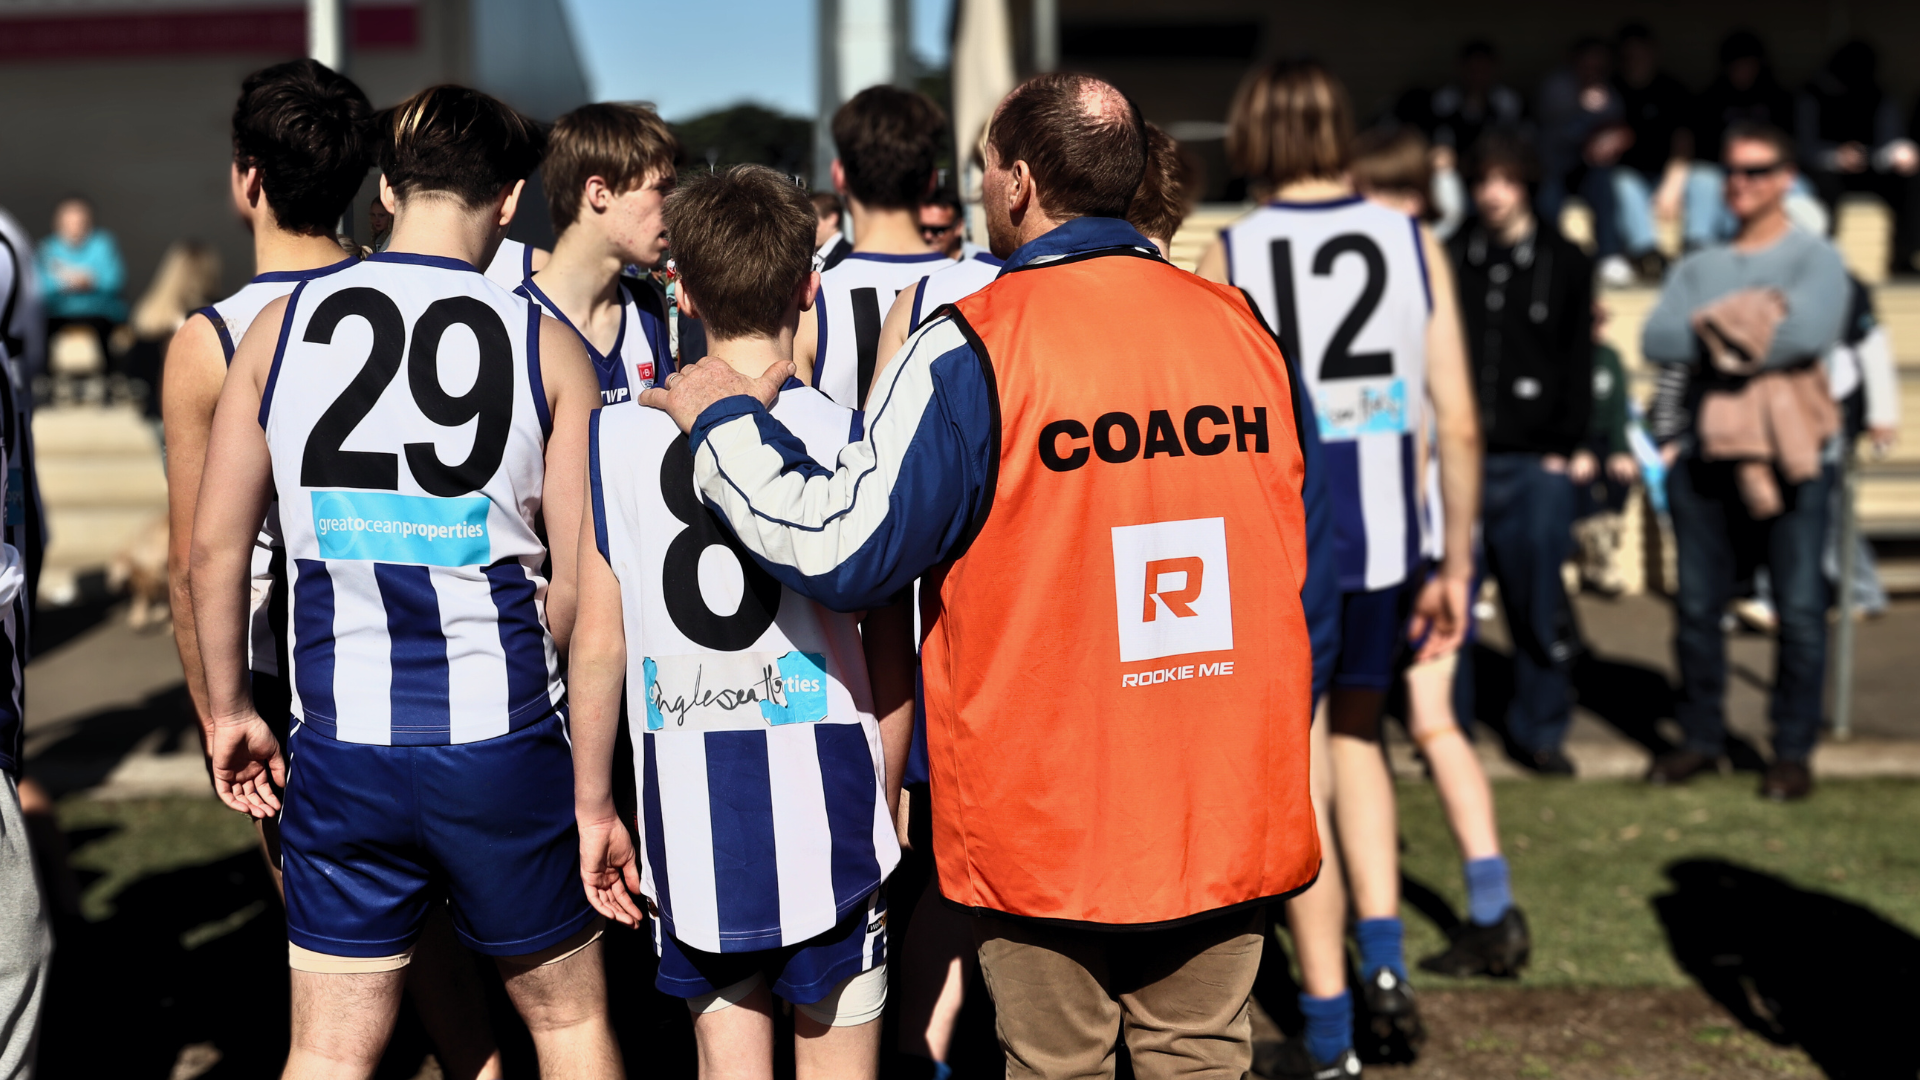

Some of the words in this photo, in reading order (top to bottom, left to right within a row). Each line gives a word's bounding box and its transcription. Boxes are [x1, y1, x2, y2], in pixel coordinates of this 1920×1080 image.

[1269, 233, 1394, 381] 12
[300, 287, 514, 497] 29
[1038, 404, 1270, 472] COACH
[319, 516, 484, 541] greatoceanproperties
[660, 431, 782, 651] 8
[1142, 556, 1204, 623] R
[1121, 665, 1195, 688] ROOKIE
[1199, 661, 1235, 678] ME
